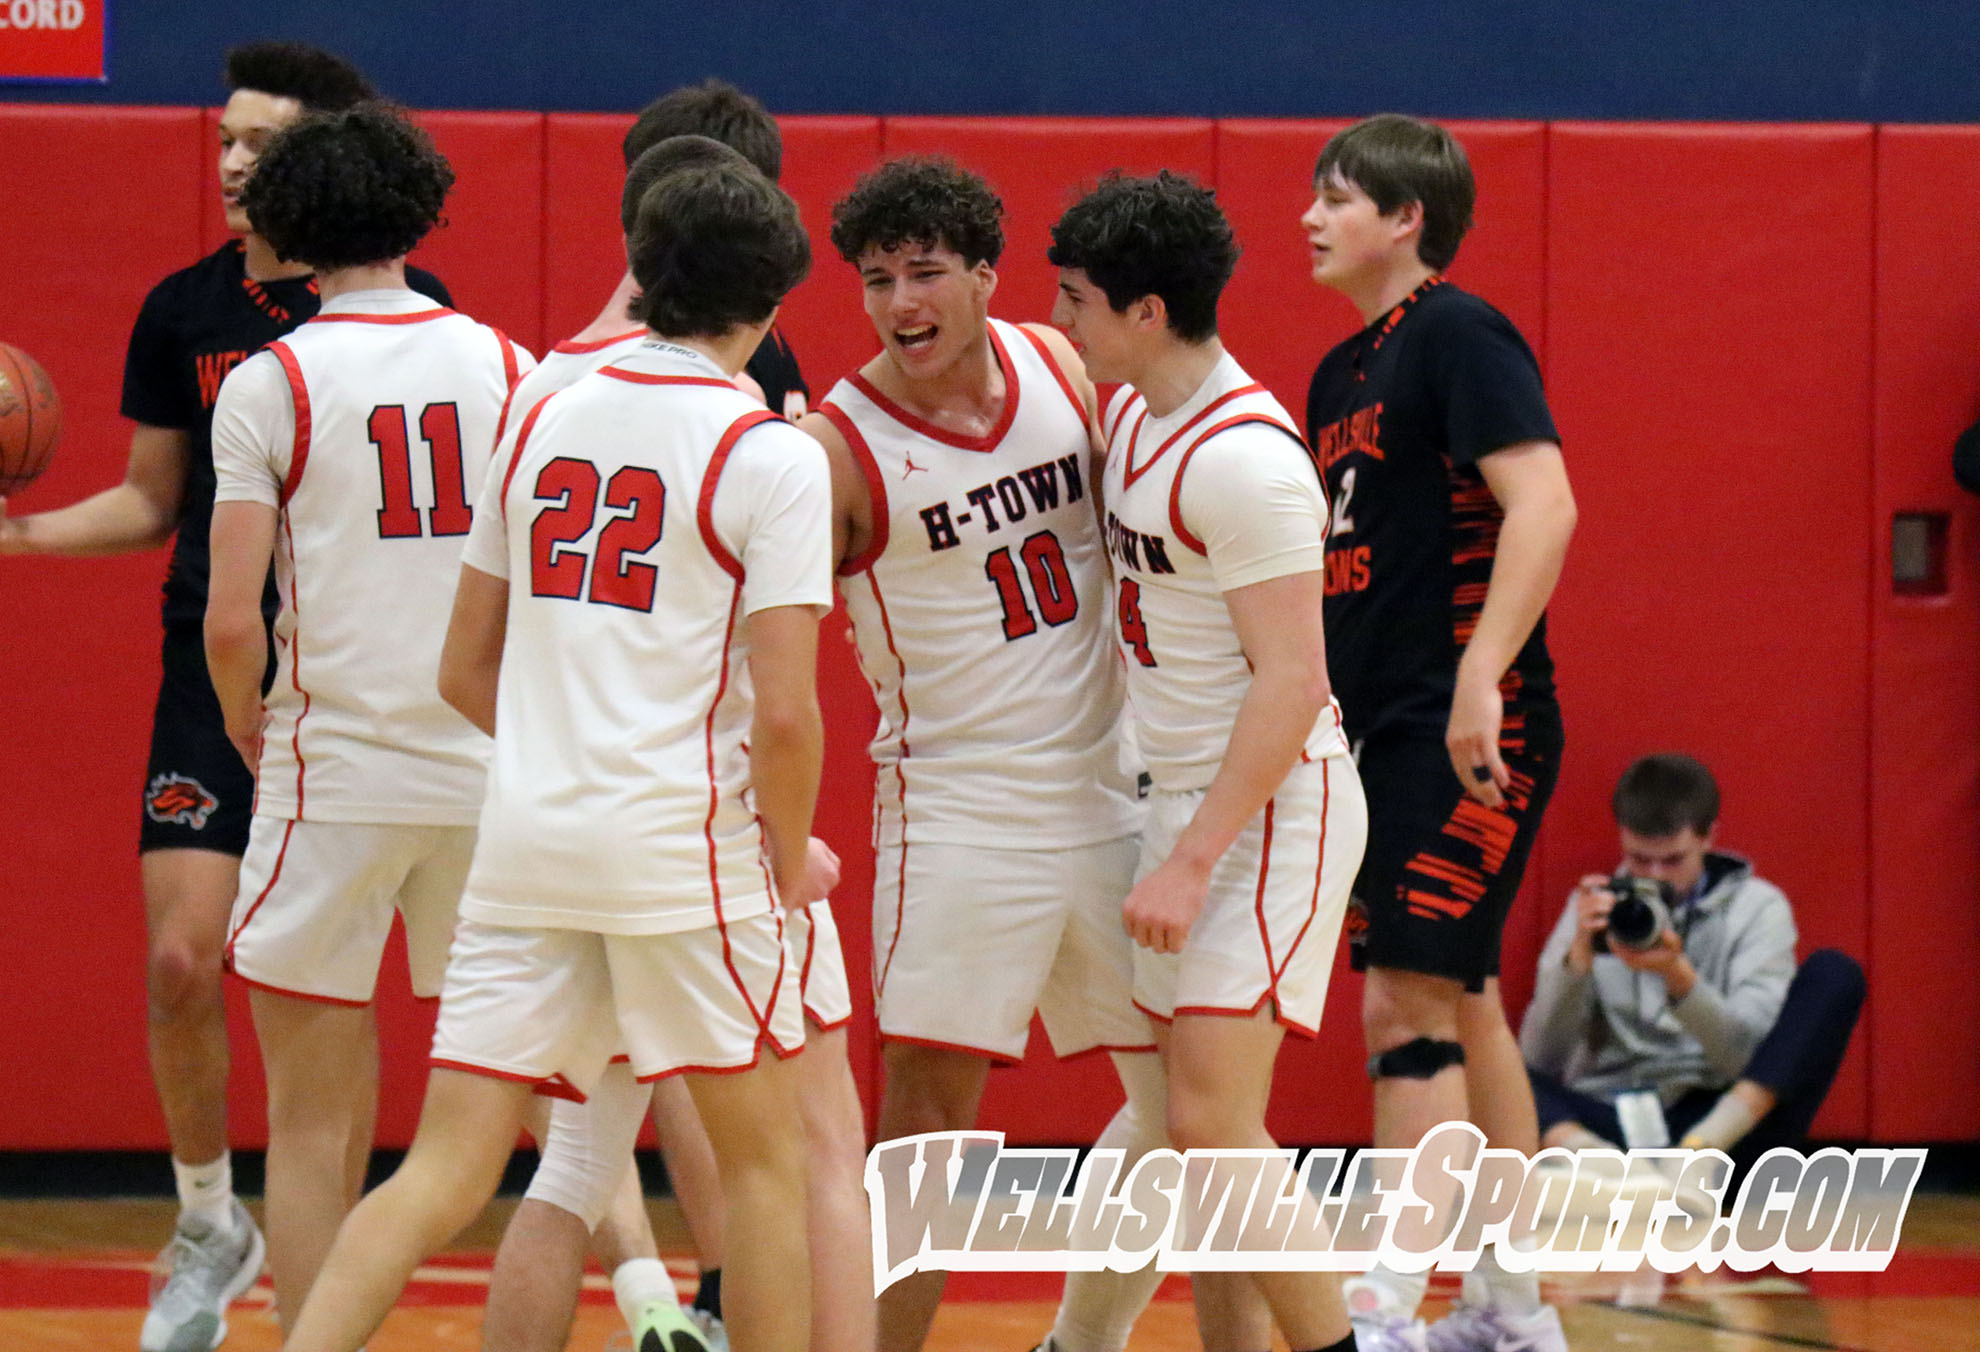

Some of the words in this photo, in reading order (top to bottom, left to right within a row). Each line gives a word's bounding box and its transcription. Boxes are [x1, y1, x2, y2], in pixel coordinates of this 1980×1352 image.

[367, 401, 473, 539] 11
[918, 453, 1083, 552] H-TOWN
[530, 456, 667, 613] 22
[984, 529, 1078, 642] 10
[1118, 576, 1158, 667] 4
